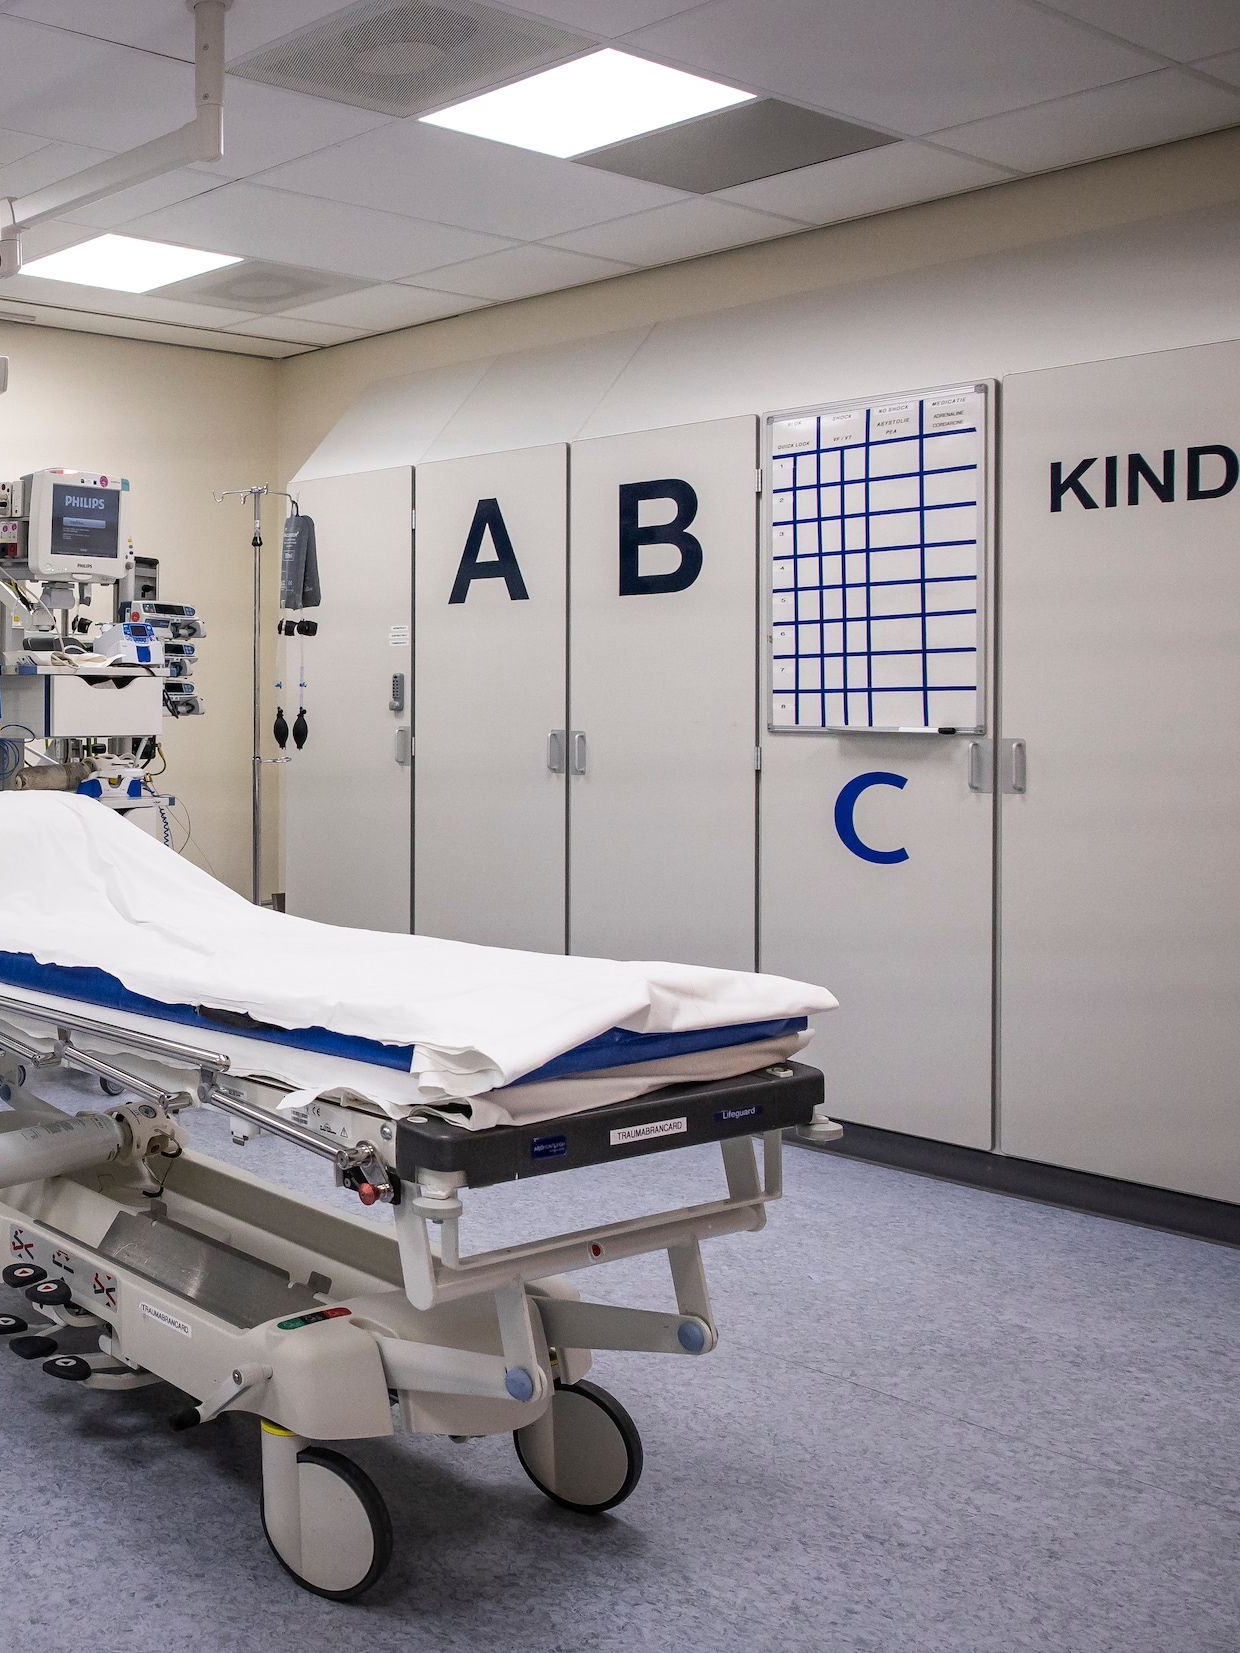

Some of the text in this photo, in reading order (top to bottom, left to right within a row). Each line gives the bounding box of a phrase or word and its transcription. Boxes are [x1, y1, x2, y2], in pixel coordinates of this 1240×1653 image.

[932, 397, 967, 406] MEDICATIE
[877, 418, 910, 427] ASYSTOLIE
[933, 410, 965, 418] ADRENALINE
[1050, 444, 1240, 513] KIND
[65, 495, 105, 510] PHILIPS
[619, 479, 704, 596] B
[448, 497, 530, 605] A
[834, 771, 910, 865] C
[722, 1107, 756, 1120] Lifeguard
[617, 1121, 683, 1141] TRAUMABRANCARD
[141, 1304, 189, 1334] TRAUMABRANCARD
